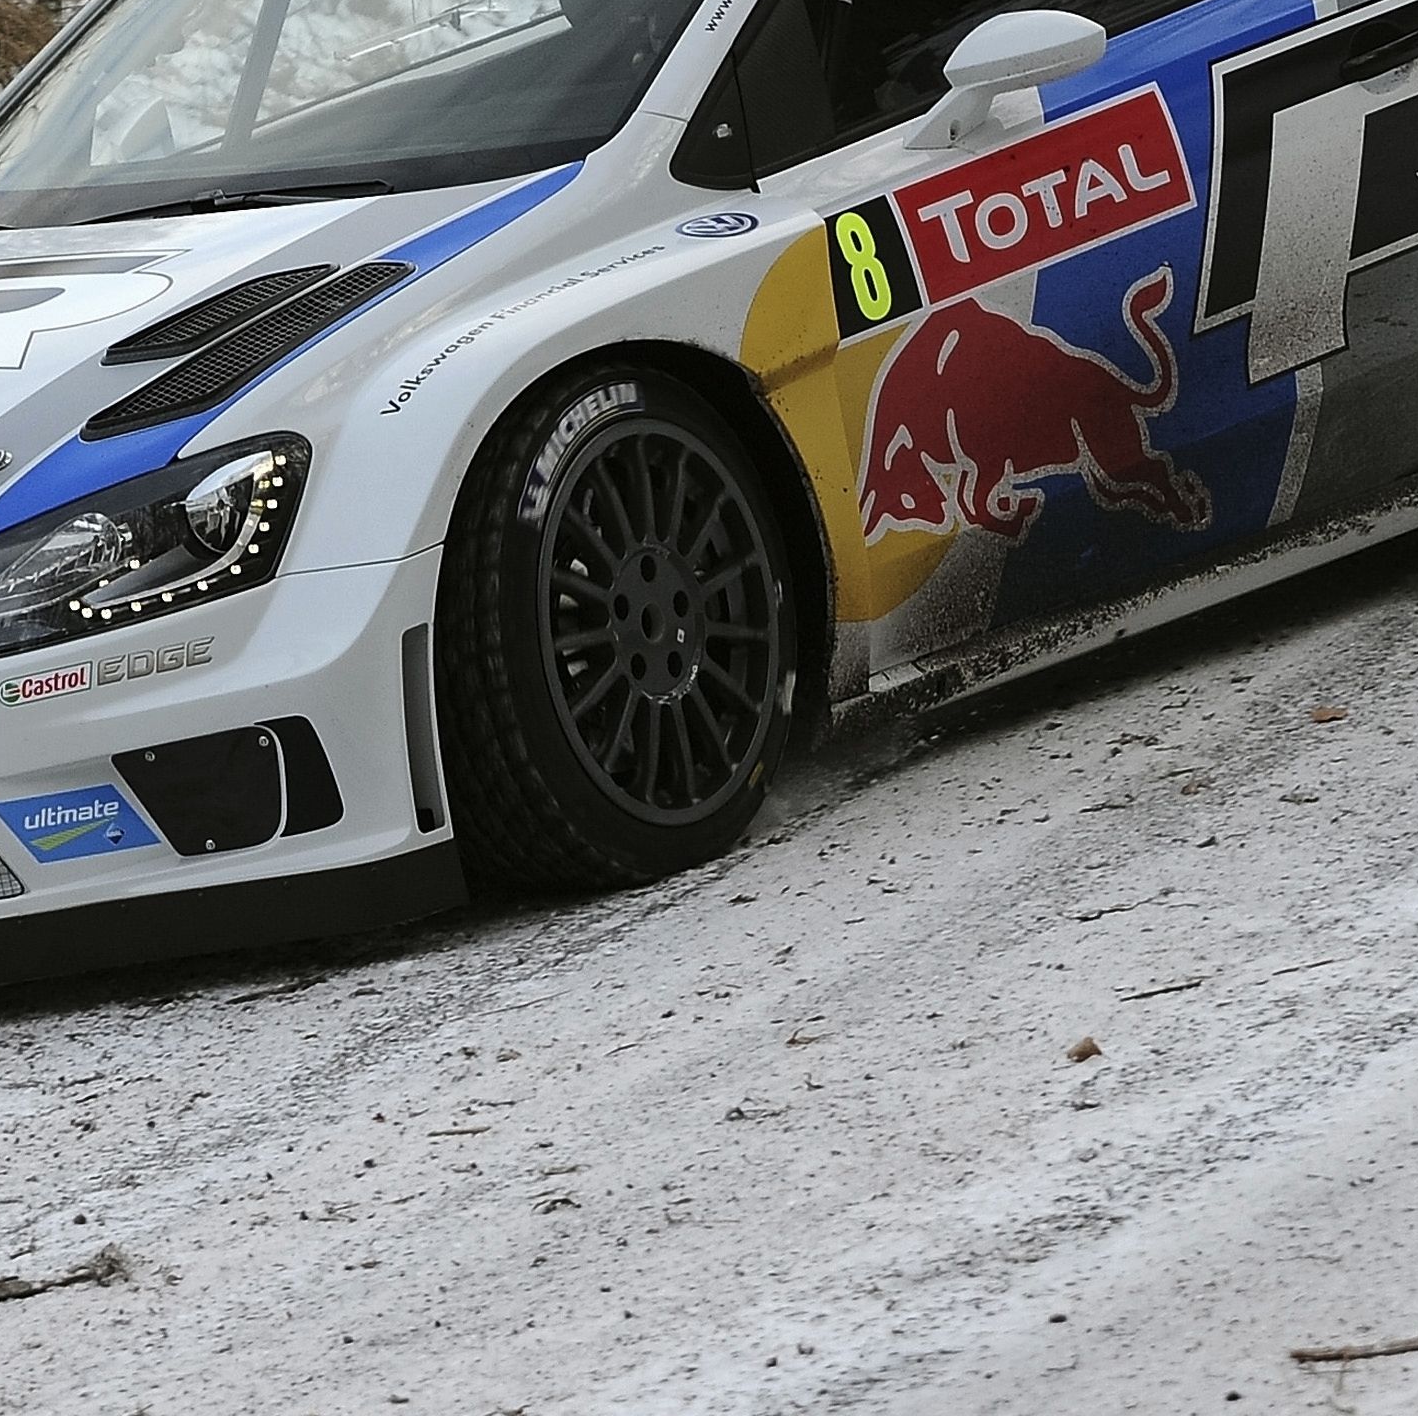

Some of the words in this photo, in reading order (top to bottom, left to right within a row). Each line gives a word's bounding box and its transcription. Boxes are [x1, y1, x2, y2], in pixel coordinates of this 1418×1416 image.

[918, 143, 1171, 264] TOTAL
[835, 211, 893, 322] 8
[380, 320, 494, 417] Volkswagen
[490, 277, 581, 320] Financial
[580, 243, 667, 283] Services
[21, 668, 87, 699] Castrol
[97, 636, 215, 685] EDGE
[24, 798, 120, 830] ultimate
